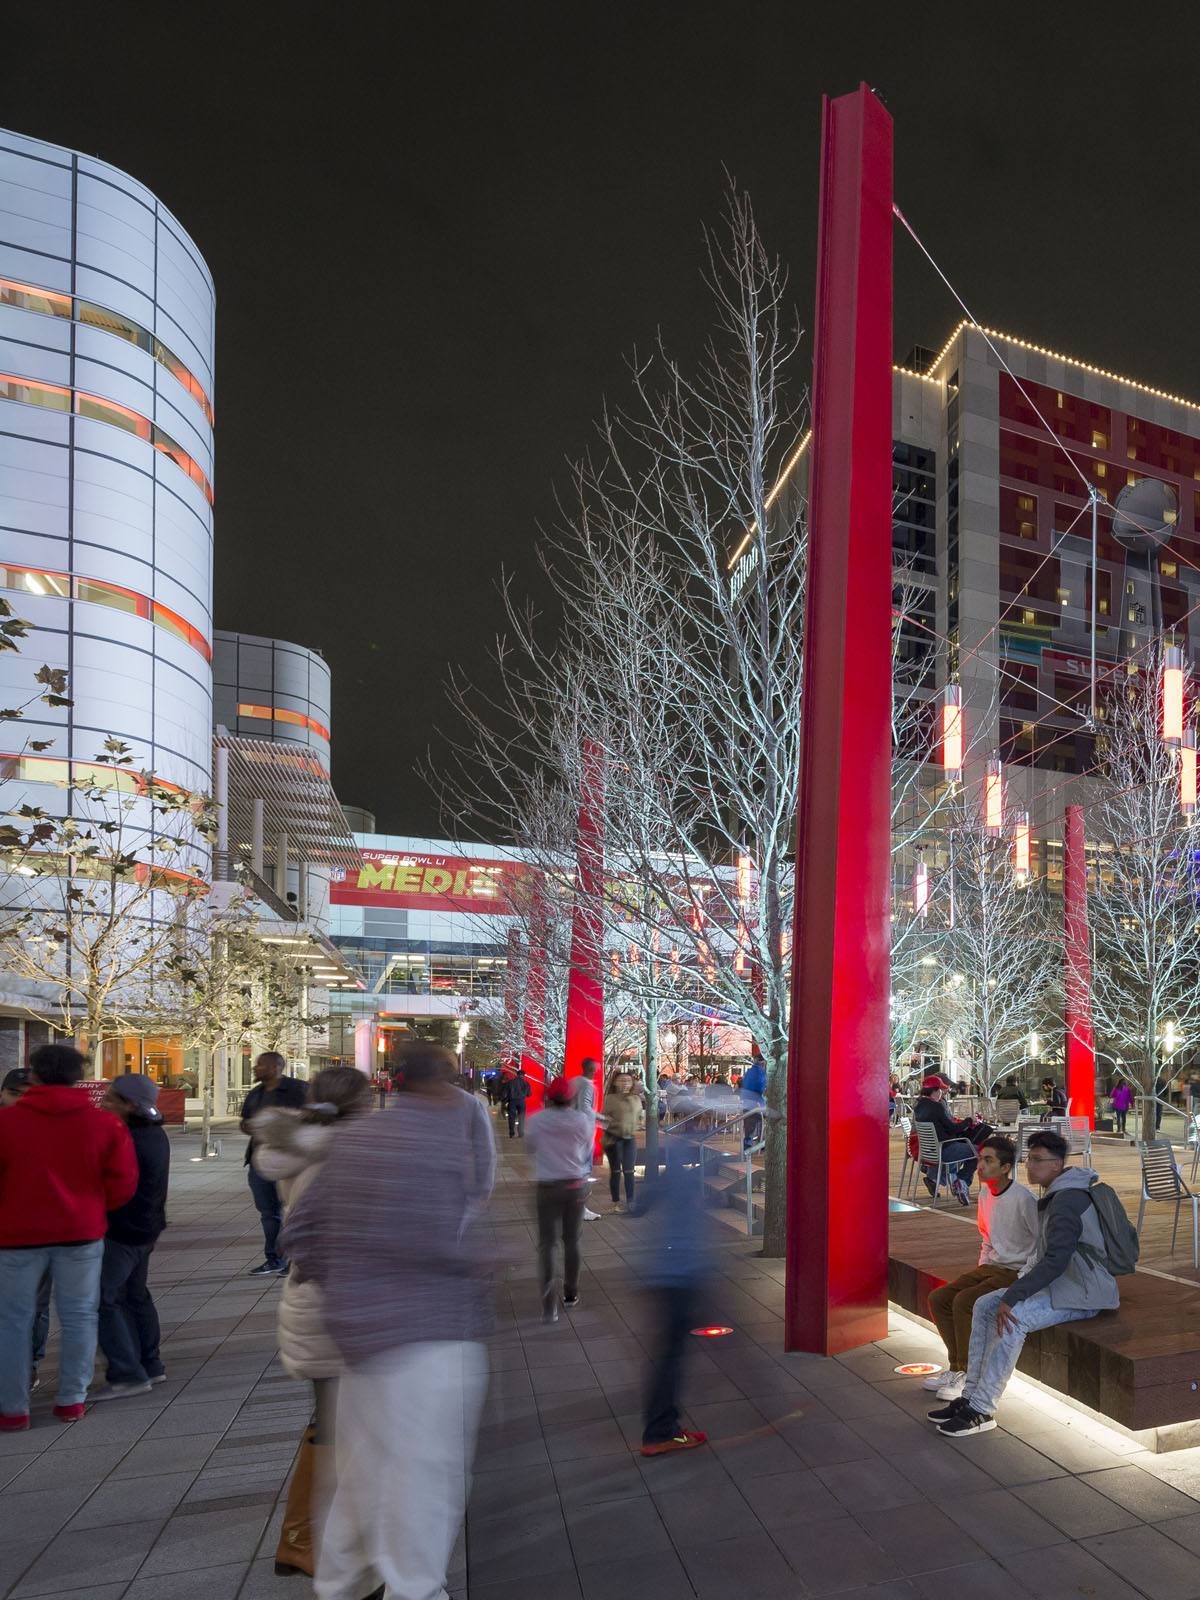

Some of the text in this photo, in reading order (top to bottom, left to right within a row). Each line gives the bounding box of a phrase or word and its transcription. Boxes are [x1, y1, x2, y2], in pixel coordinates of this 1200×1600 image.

[361, 852, 400, 861] SUPER
[402, 856, 433, 865] BOWL
[330, 871, 344, 879] NFL
[357, 862, 499, 898] MEDIA
